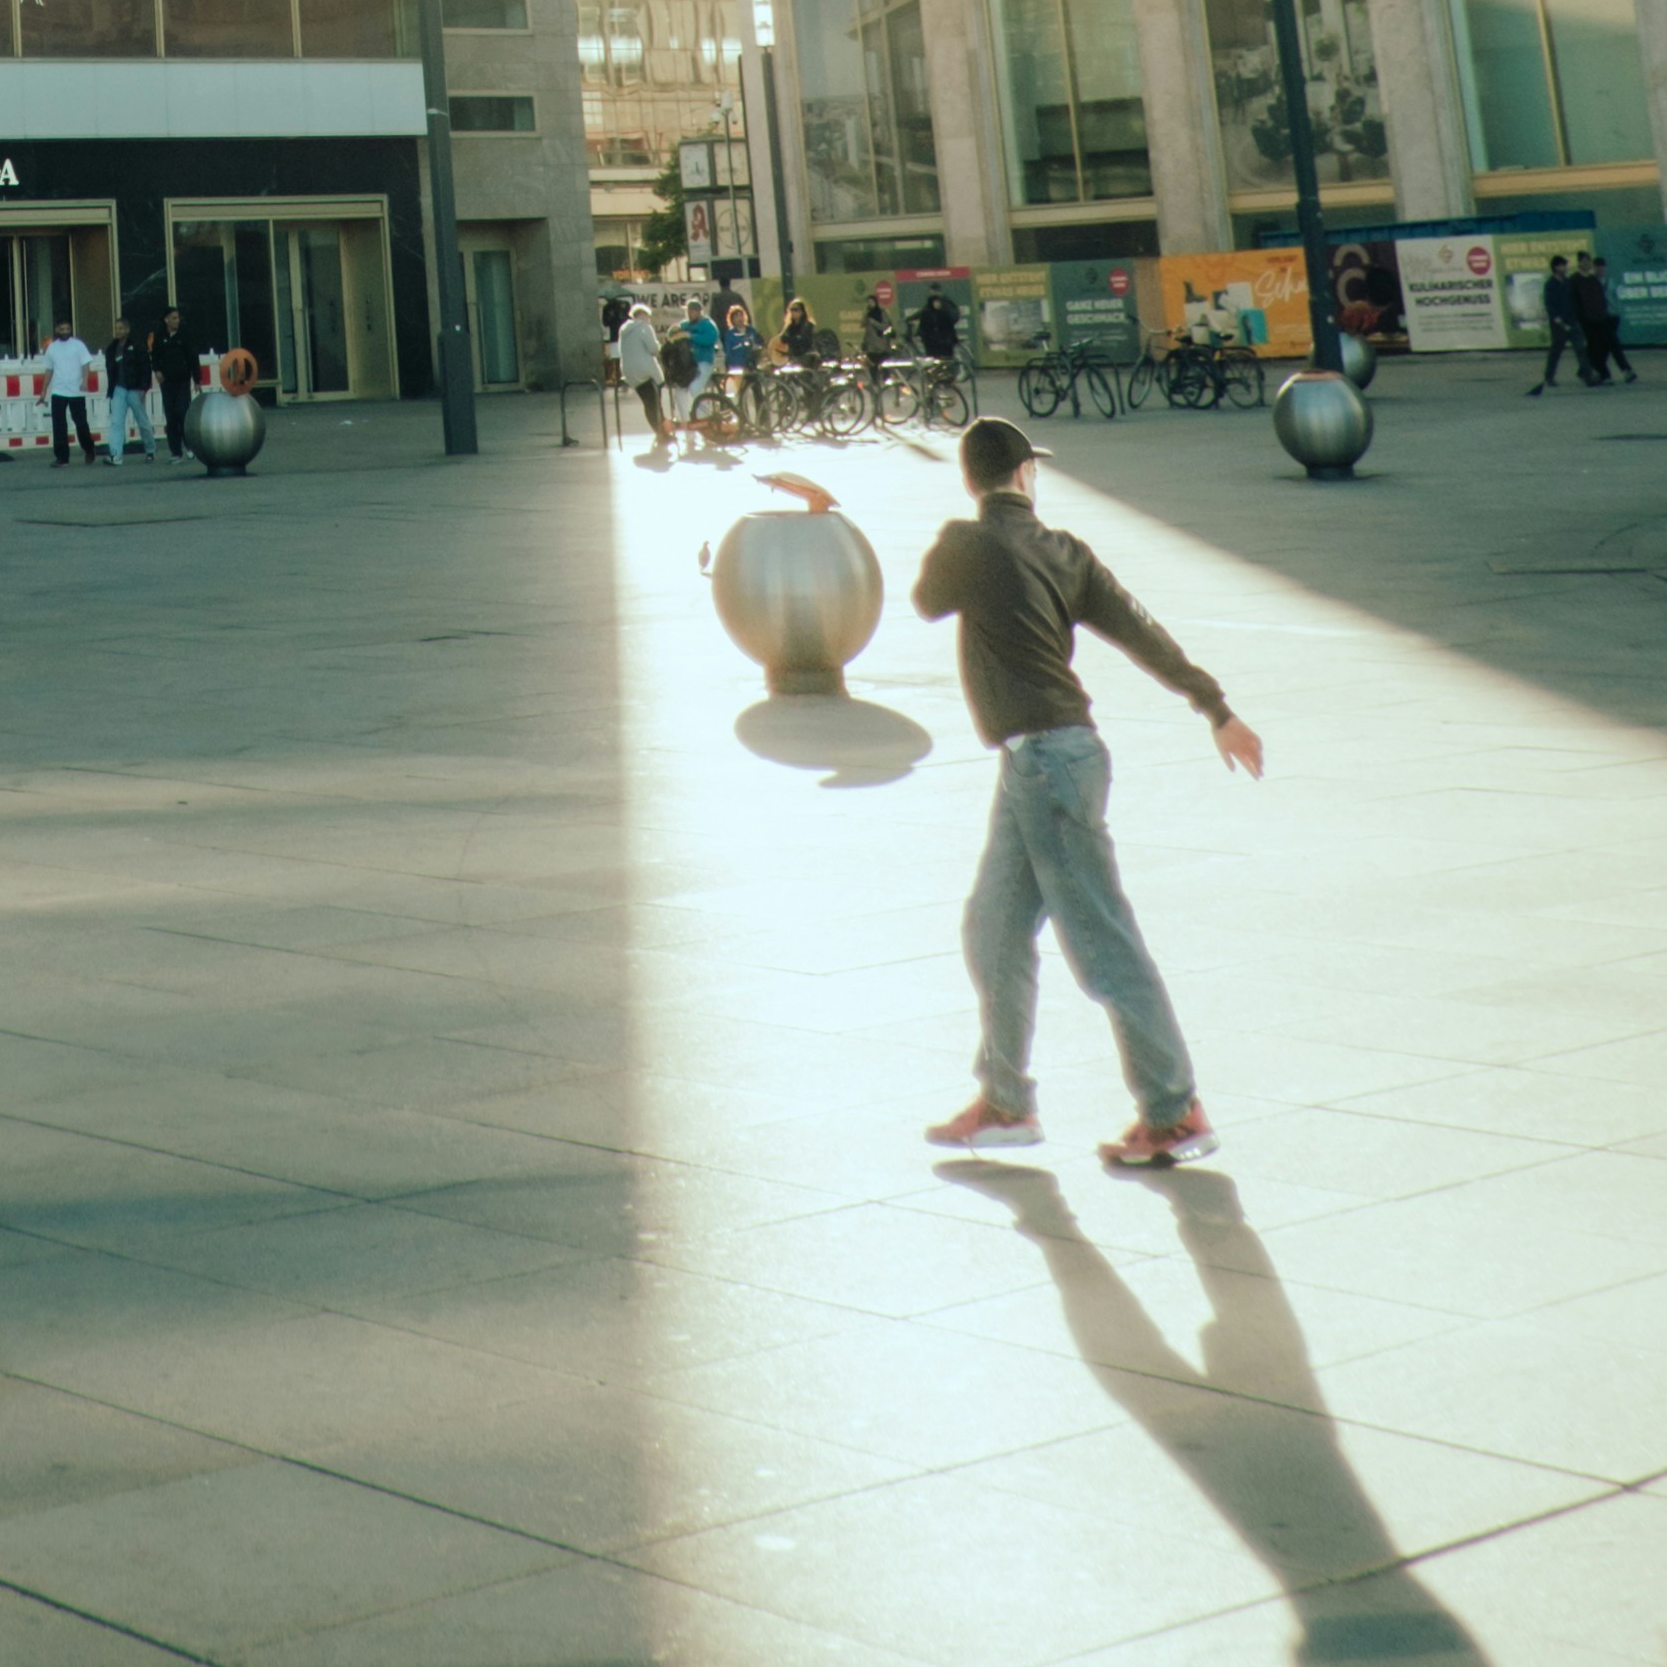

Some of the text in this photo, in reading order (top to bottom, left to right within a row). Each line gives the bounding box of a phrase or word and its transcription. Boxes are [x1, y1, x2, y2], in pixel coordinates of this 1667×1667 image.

[1408, 278, 1494, 293] KULINARISCHER
[661, 292, 687, 308] ARE
[1415, 293, 1491, 307] HOCHGENUSS
